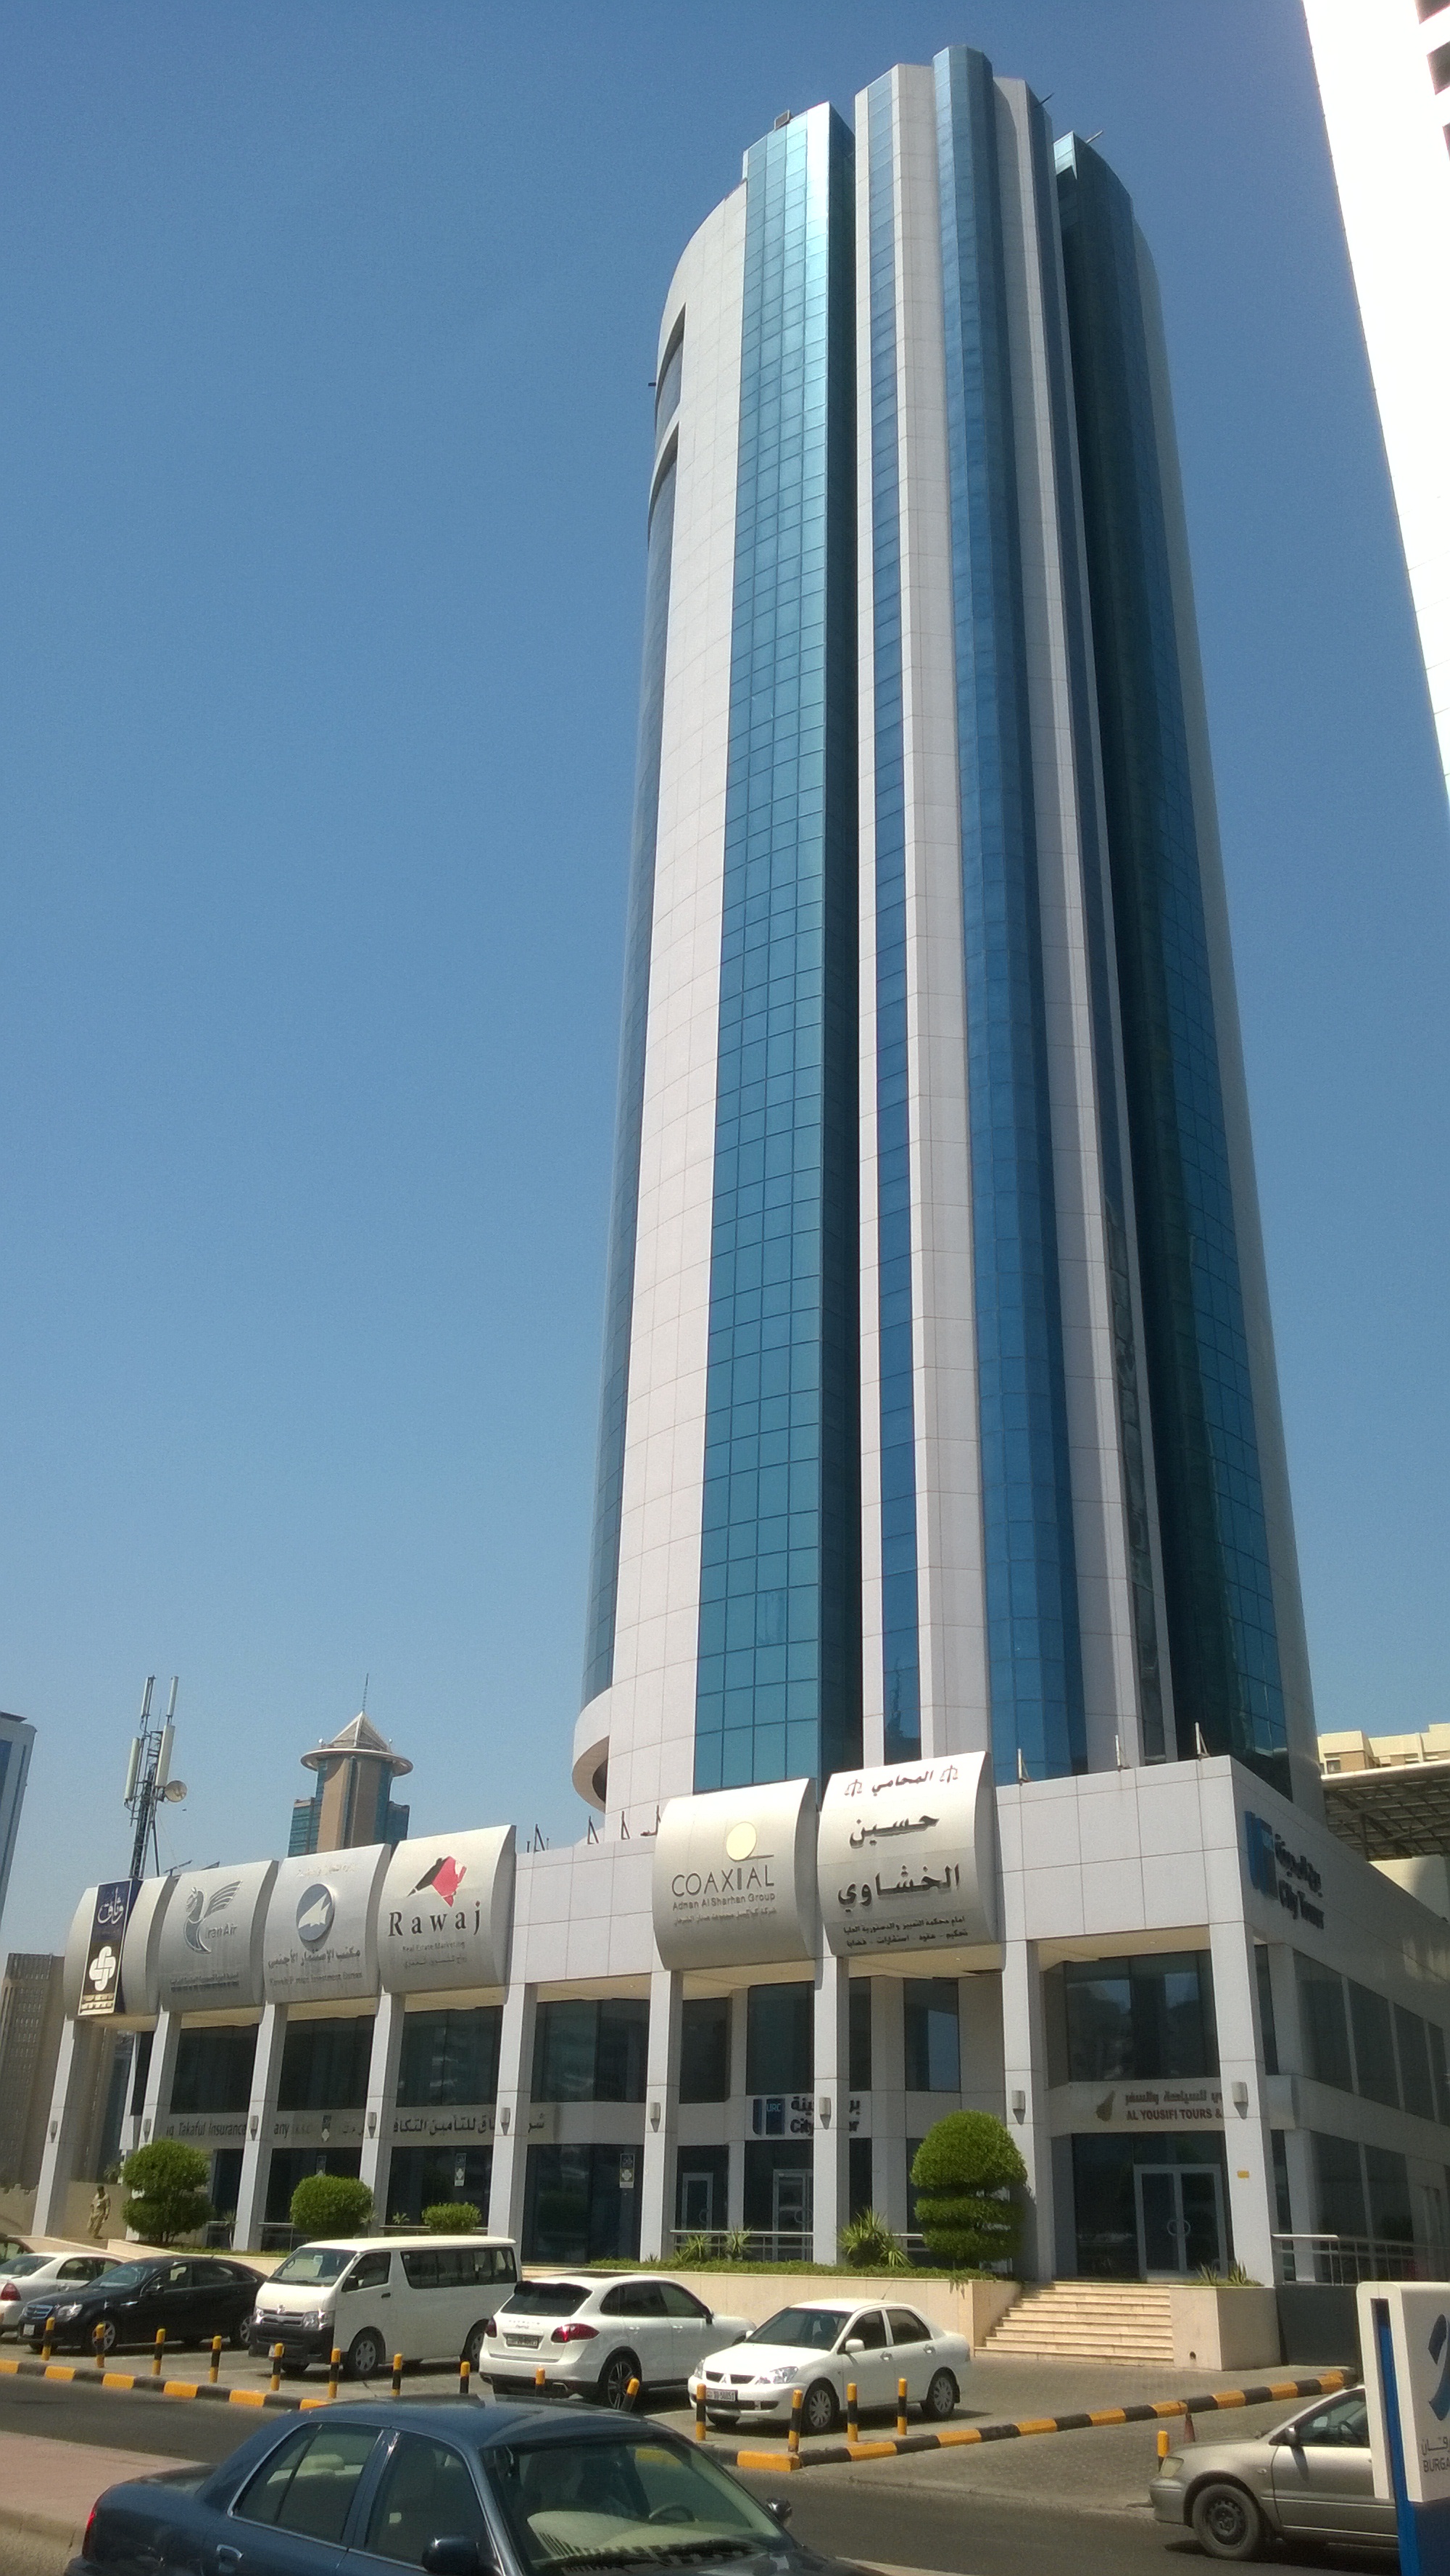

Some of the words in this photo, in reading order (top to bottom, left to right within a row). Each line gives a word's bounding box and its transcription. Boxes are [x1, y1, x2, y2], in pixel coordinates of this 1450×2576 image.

[871, 1770, 935, 1797] المحامي
[849, 1815, 940, 1849] حسين
[671, 1864, 775, 1897] COAXIAL
[837, 1862, 960, 1913] الخشاوي
[673, 1901, 700, 1911] Adnan
[702, 1897, 710, 1907] Al
[747, 1892, 776, 1902] Group
[388, 1900, 481, 1937] Rawaj
[926, 1917, 950, 1926] محكمة
[843, 1925, 861, 1936] العليا
[876, 1934, 910, 1946] استشارات
[945, 1928, 969, 1940] تحكيم
[1127, 2110, 1139, 2121] AL
[1140, 2108, 1177, 2121] YOUSIFI
[1180, 2108, 1212, 2120] TOURS
[1214, 2108, 1222, 2119] &
[179, 2120, 207, 2136] Takaful
[429, 2115, 476, 2136] للتأمين
